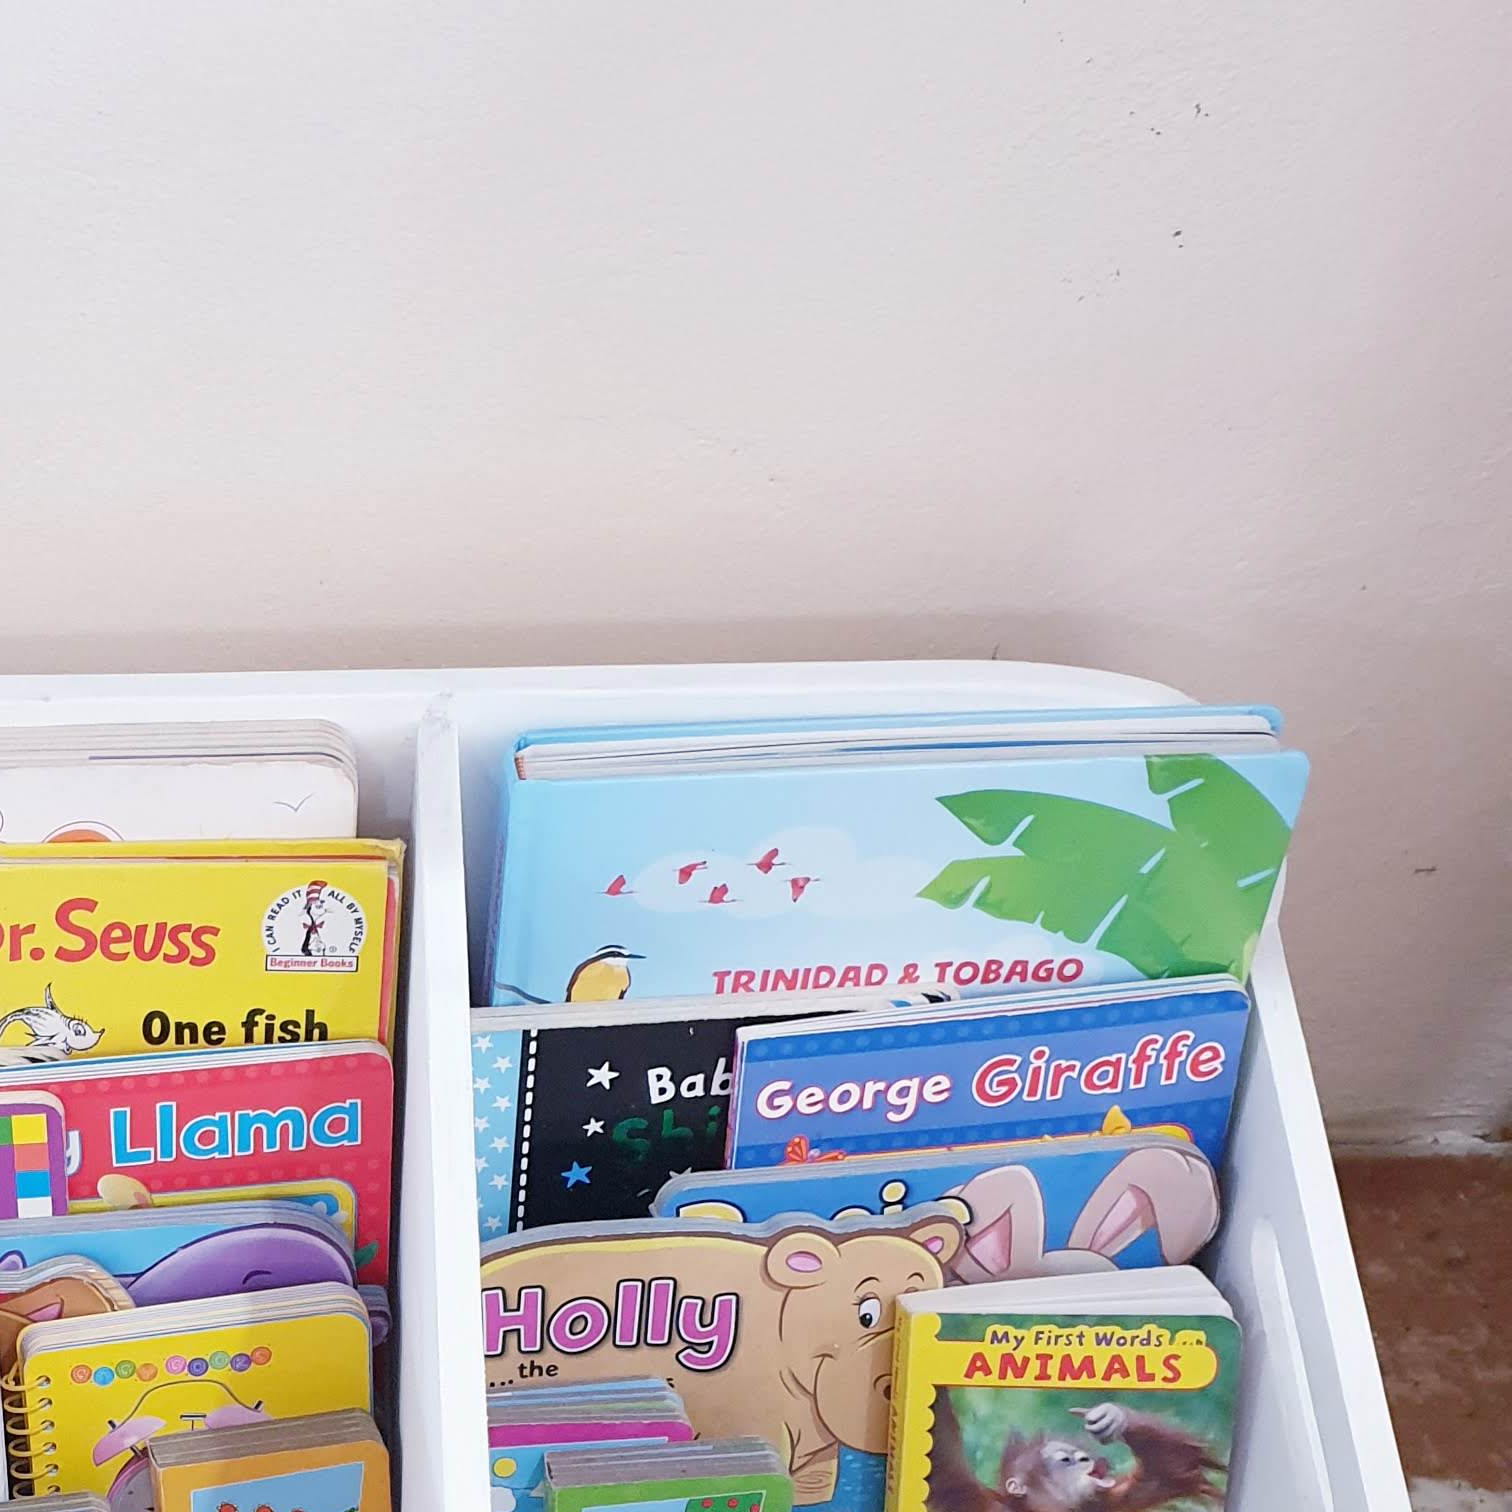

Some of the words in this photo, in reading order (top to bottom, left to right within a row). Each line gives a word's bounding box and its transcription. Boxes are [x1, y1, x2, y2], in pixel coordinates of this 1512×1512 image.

[267, 896, 290, 921] READ
[292, 889, 303, 900] IT
[327, 890, 346, 904] ALL
[346, 902, 360, 914] BY
[54, 897, 221, 968] Seuss
[265, 925, 277, 945] CAN
[348, 917, 364, 954] MYSELF
[270, 957, 317, 968] Beginner
[320, 957, 354, 968] Books
[711, 963, 888, 995] TRINIDAD
[897, 962, 920, 985] &
[934, 958, 1085, 986] TOBAGO
[141, 1009, 227, 1047] One
[240, 1009, 329, 1044] fish
[647, 1057, 734, 1105] Bab
[755, 1072, 952, 1122] George
[972, 1030, 1225, 1108] Giraffe
[110, 1099, 361, 1167] Llama
[481, 1277, 740, 1373] Holly
[989, 1329, 1026, 1351] My
[1033, 1330, 1085, 1347] First
[1094, 1329, 1165, 1348] Words
[518, 1360, 560, 1380] the
[963, 1351, 1183, 1384] ANIMALS
